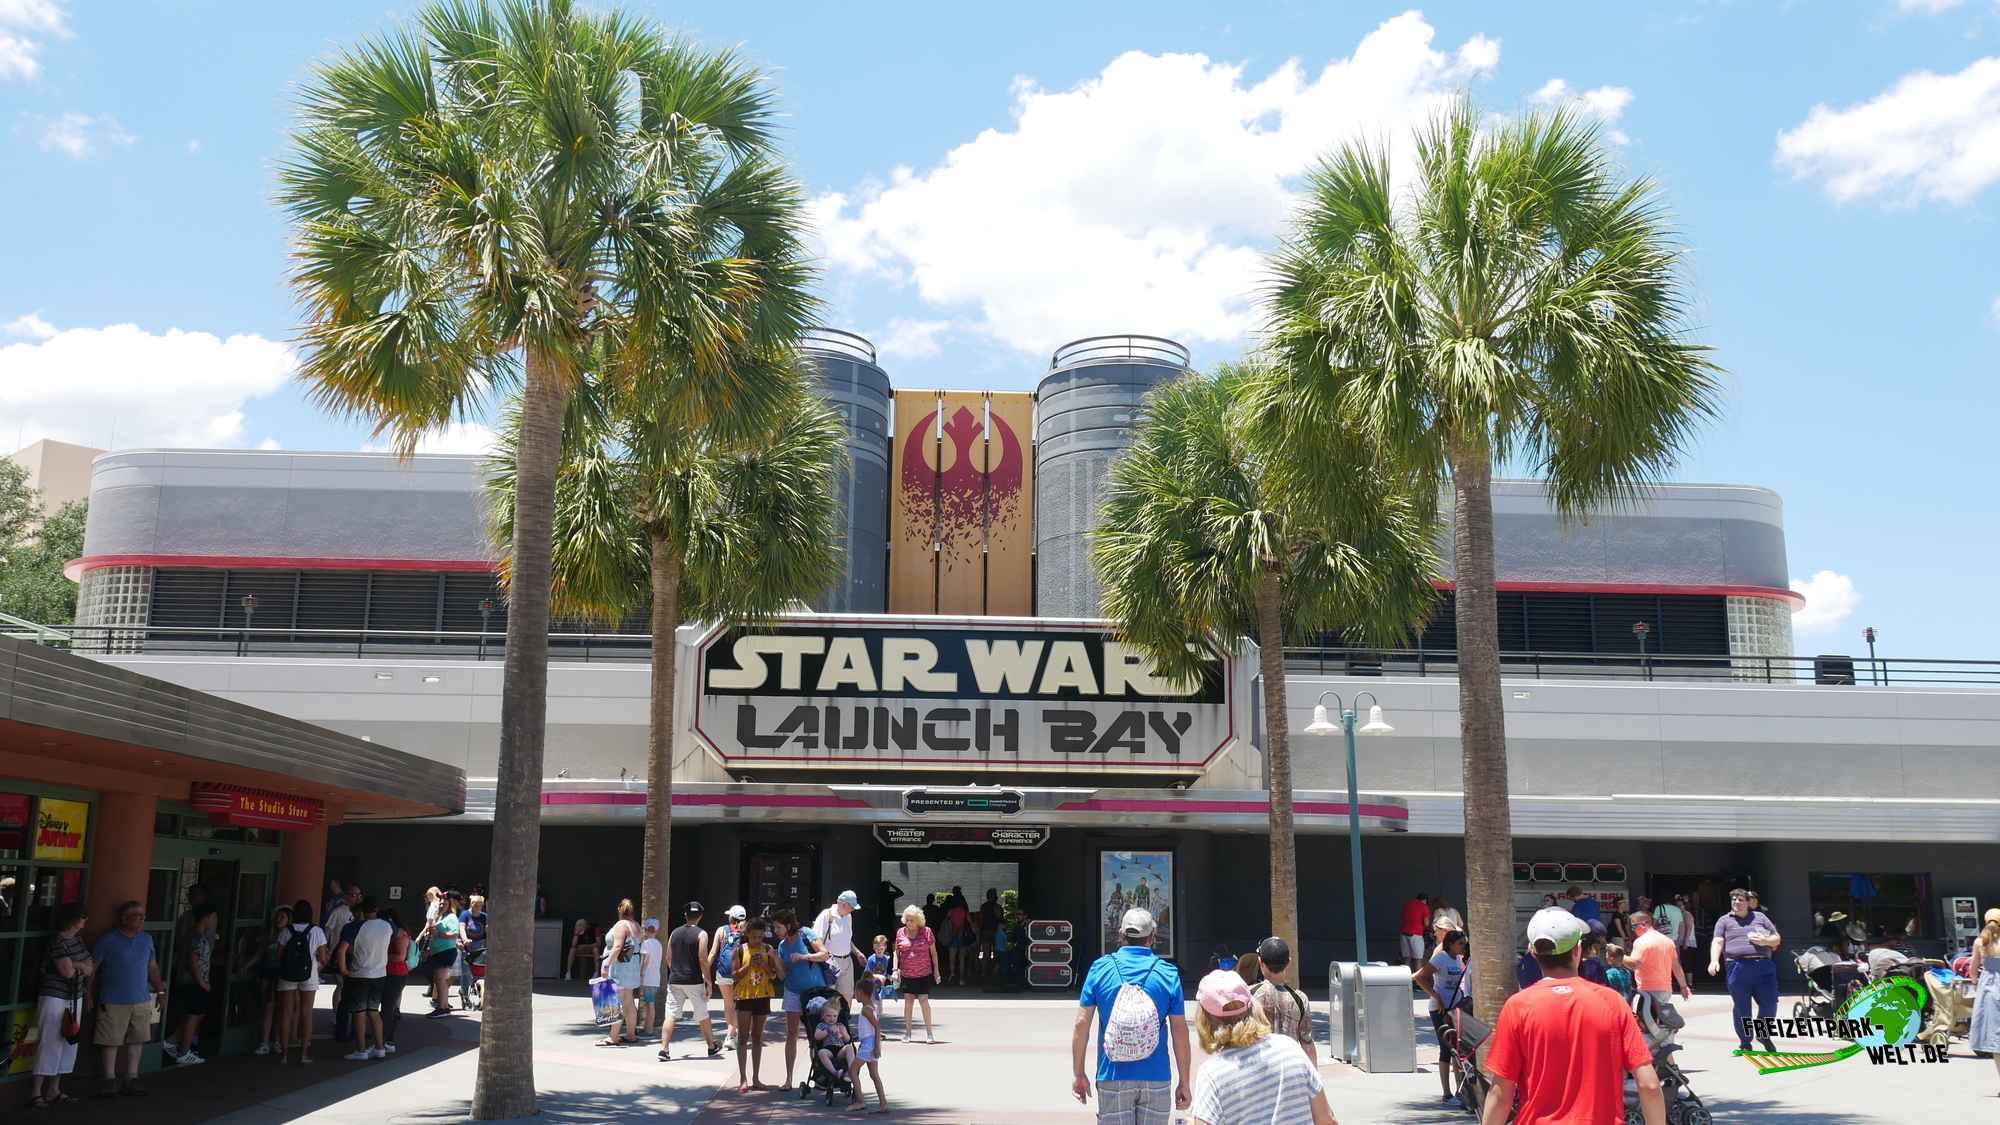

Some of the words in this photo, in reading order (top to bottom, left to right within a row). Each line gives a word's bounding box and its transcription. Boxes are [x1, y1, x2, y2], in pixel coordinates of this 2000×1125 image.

[709, 636, 958, 693] STAR
[736, 704, 1019, 752] LAUNCH
[1042, 709, 1192, 754] BAY
[240, 796, 255, 810] The
[258, 799, 285, 815] Studio
[288, 803, 308, 818] Store
[991, 831, 1041, 839] CHARACTER
